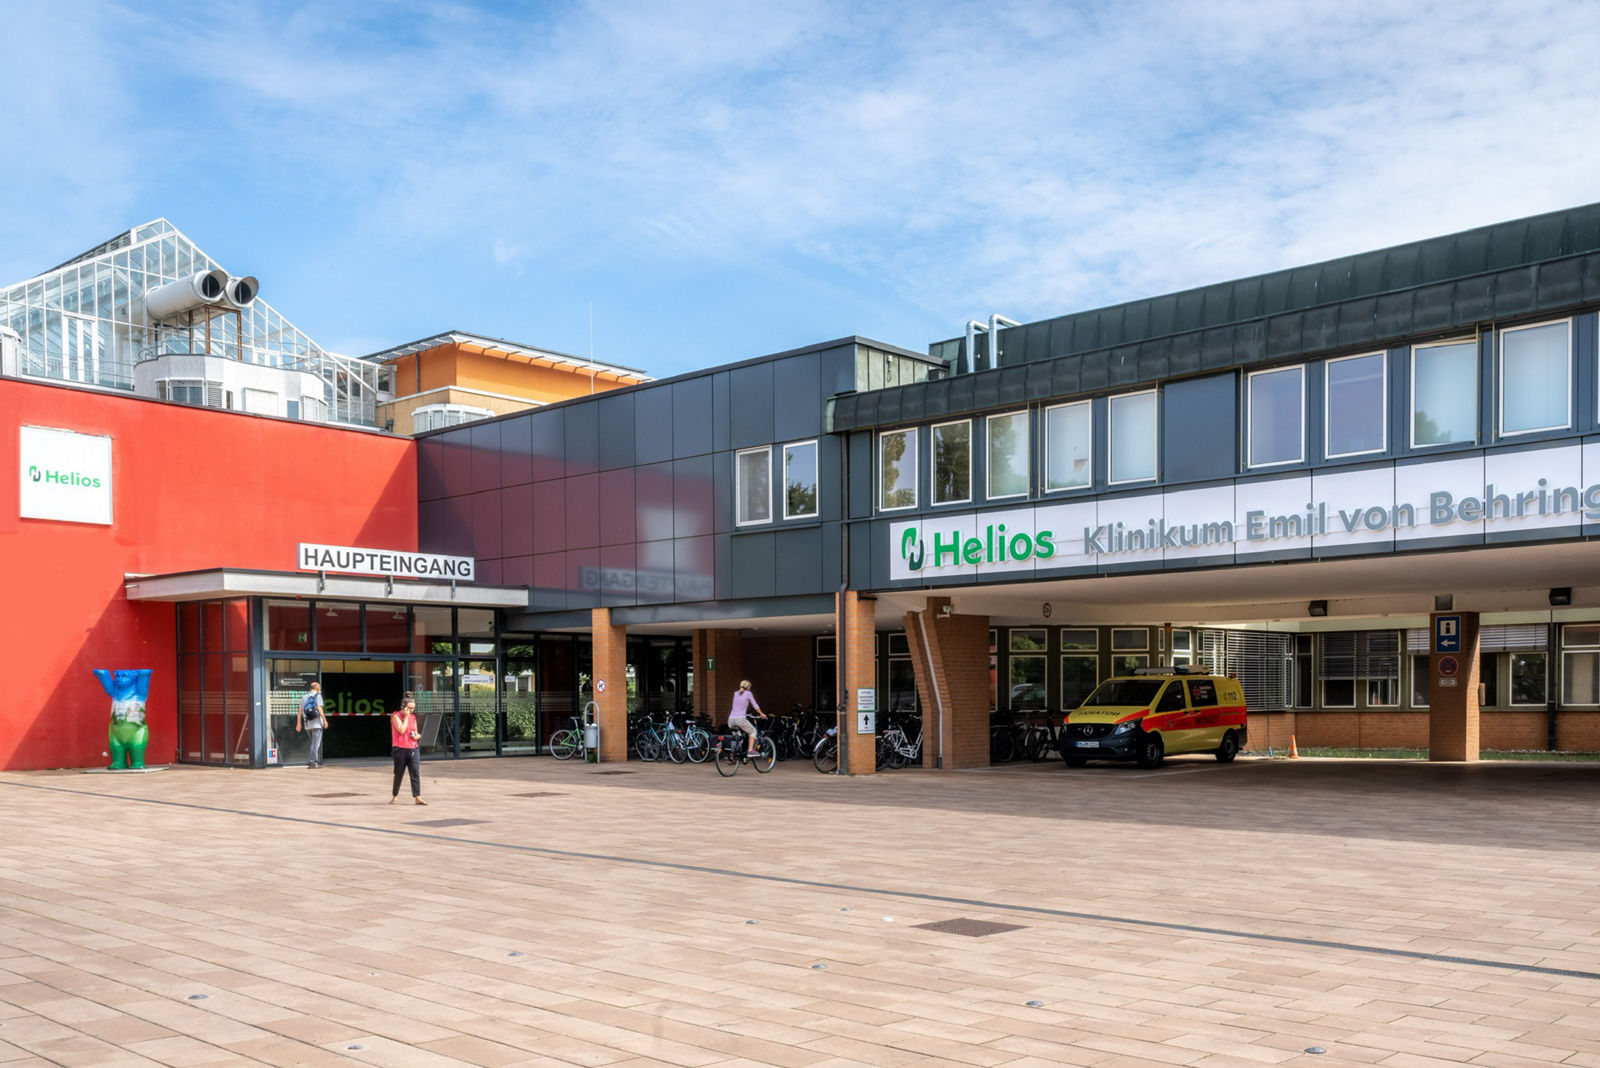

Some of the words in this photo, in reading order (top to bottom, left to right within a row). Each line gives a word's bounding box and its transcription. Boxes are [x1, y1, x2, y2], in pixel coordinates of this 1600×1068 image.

[45, 469, 101, 488] Helios
[934, 523, 1056, 567] Helios
[1083, 517, 1234, 555] Klinikum
[1246, 501, 1326, 541] Emil
[1338, 502, 1415, 533] von
[304, 547, 471, 577] HAUPTEINGANG
[323, 692, 385, 714] elios
